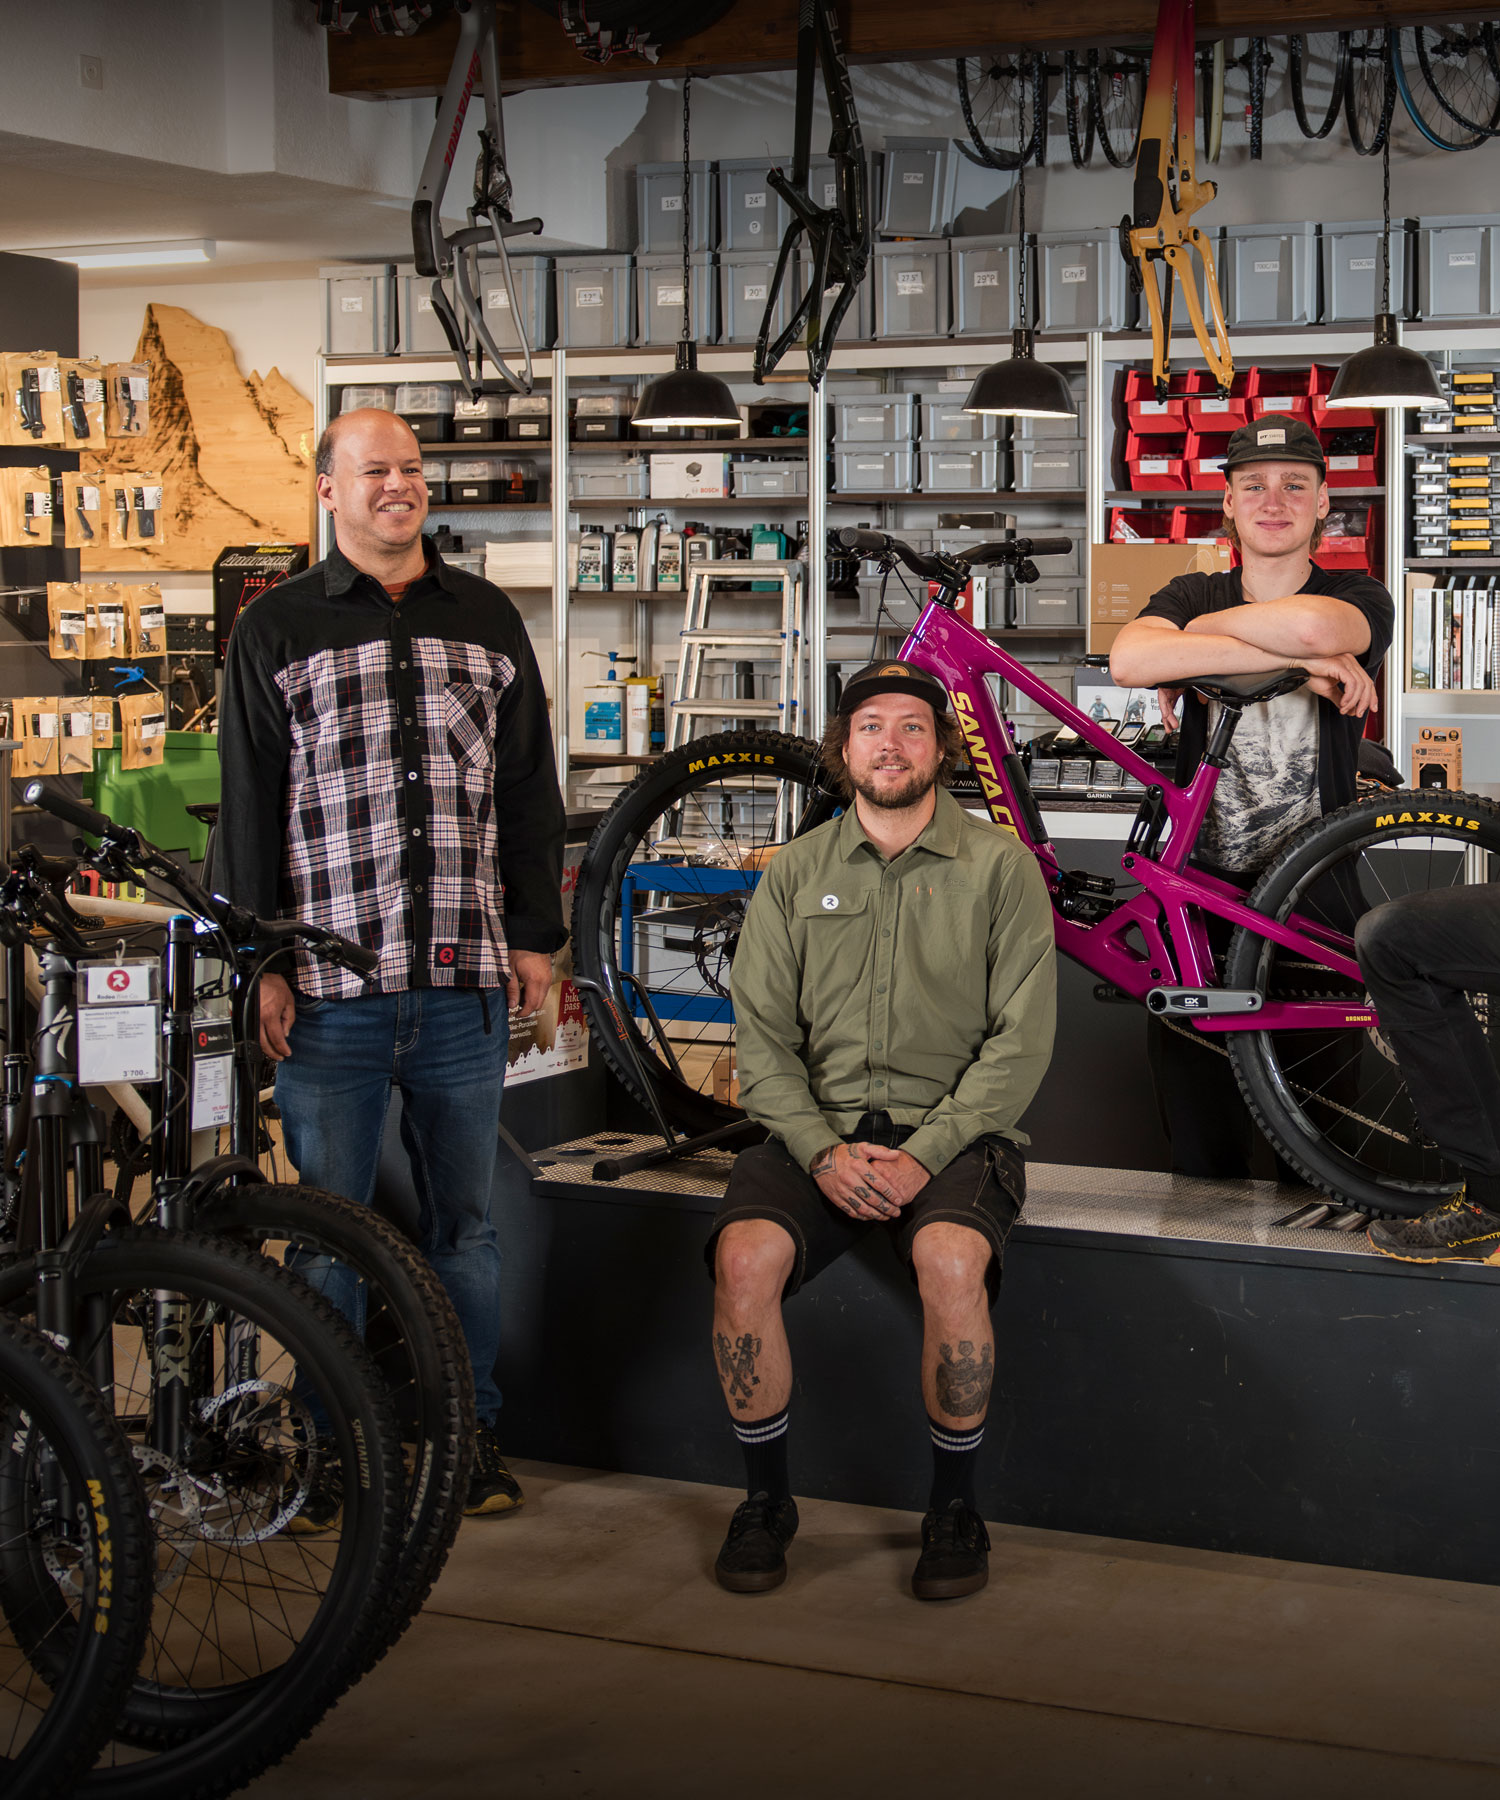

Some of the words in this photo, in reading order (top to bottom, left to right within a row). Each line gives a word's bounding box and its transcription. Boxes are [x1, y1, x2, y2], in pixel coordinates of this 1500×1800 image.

[458, 48, 480, 116] SANTA
[825, 8, 863, 149] DEVIATE
[443, 115, 464, 170] CRUZ
[1064, 270, 1078, 280] City
[688, 752, 775, 774] MAXXIS
[949, 690, 1003, 800] SANTA
[1375, 811, 1481, 831] MAXXIS
[155, 1302, 191, 1388] FOX
[351, 1418, 371, 1489] SPECIALIZED
[86, 1479, 113, 1635] MAXXIS
